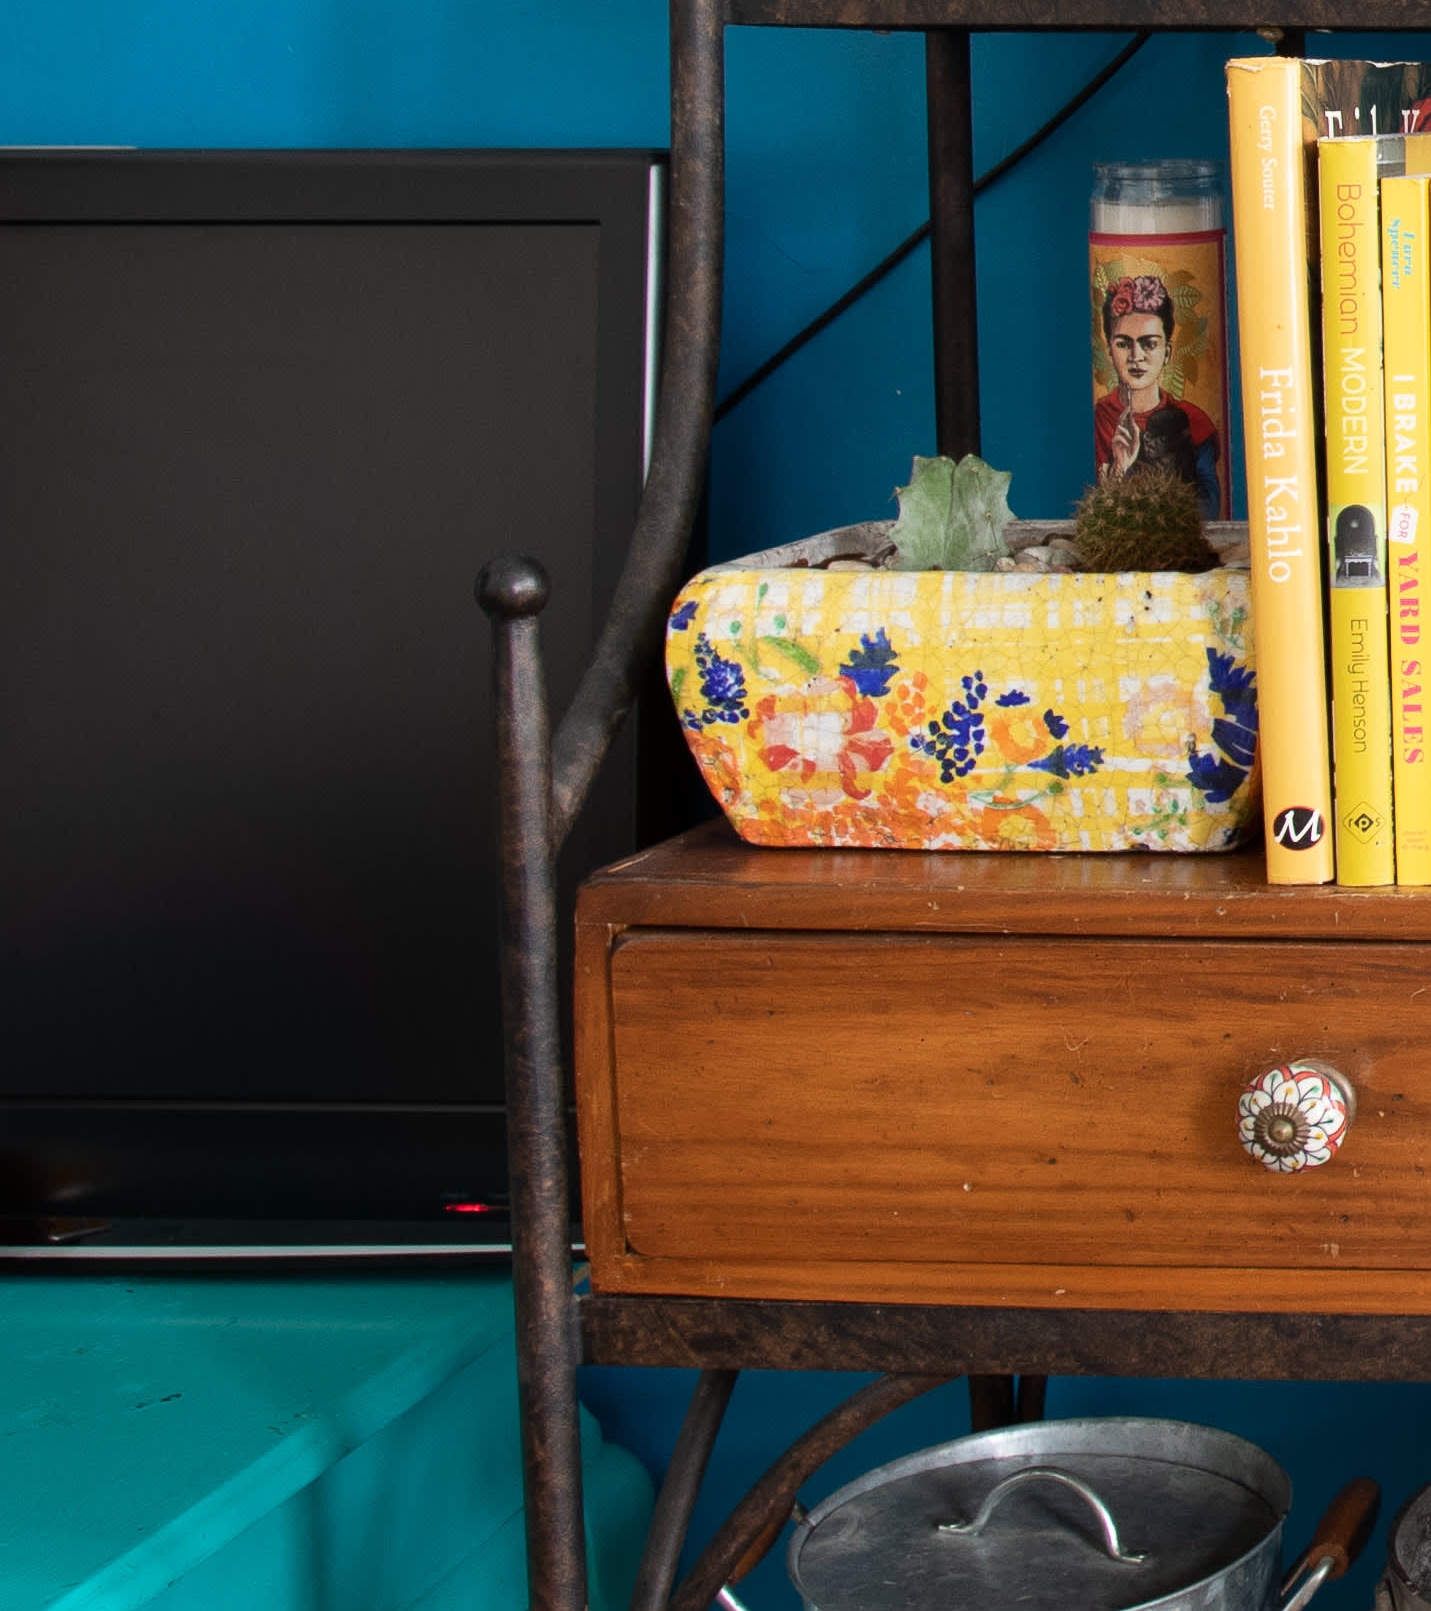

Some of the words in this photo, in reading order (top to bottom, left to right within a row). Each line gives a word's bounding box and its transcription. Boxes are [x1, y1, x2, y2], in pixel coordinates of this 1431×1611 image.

[1257, 105, 1277, 153] Gerry
[1261, 157, 1279, 211] Souter
[1336, 183, 1366, 335] Bohemian
[1260, 367, 1297, 460] Frida
[1341, 347, 1370, 474] MODERN
[1392, 374, 1416, 382] I
[1393, 393, 1418, 494] BRAKE
[1264, 475, 1303, 583] Kahlo
[1398, 512, 1411, 540] FOR
[1398, 550, 1421, 645] YARD
[1348, 618, 1370, 674] Emily
[1352, 679, 1371, 755] Henson
[1400, 659, 1424, 765] SALES
